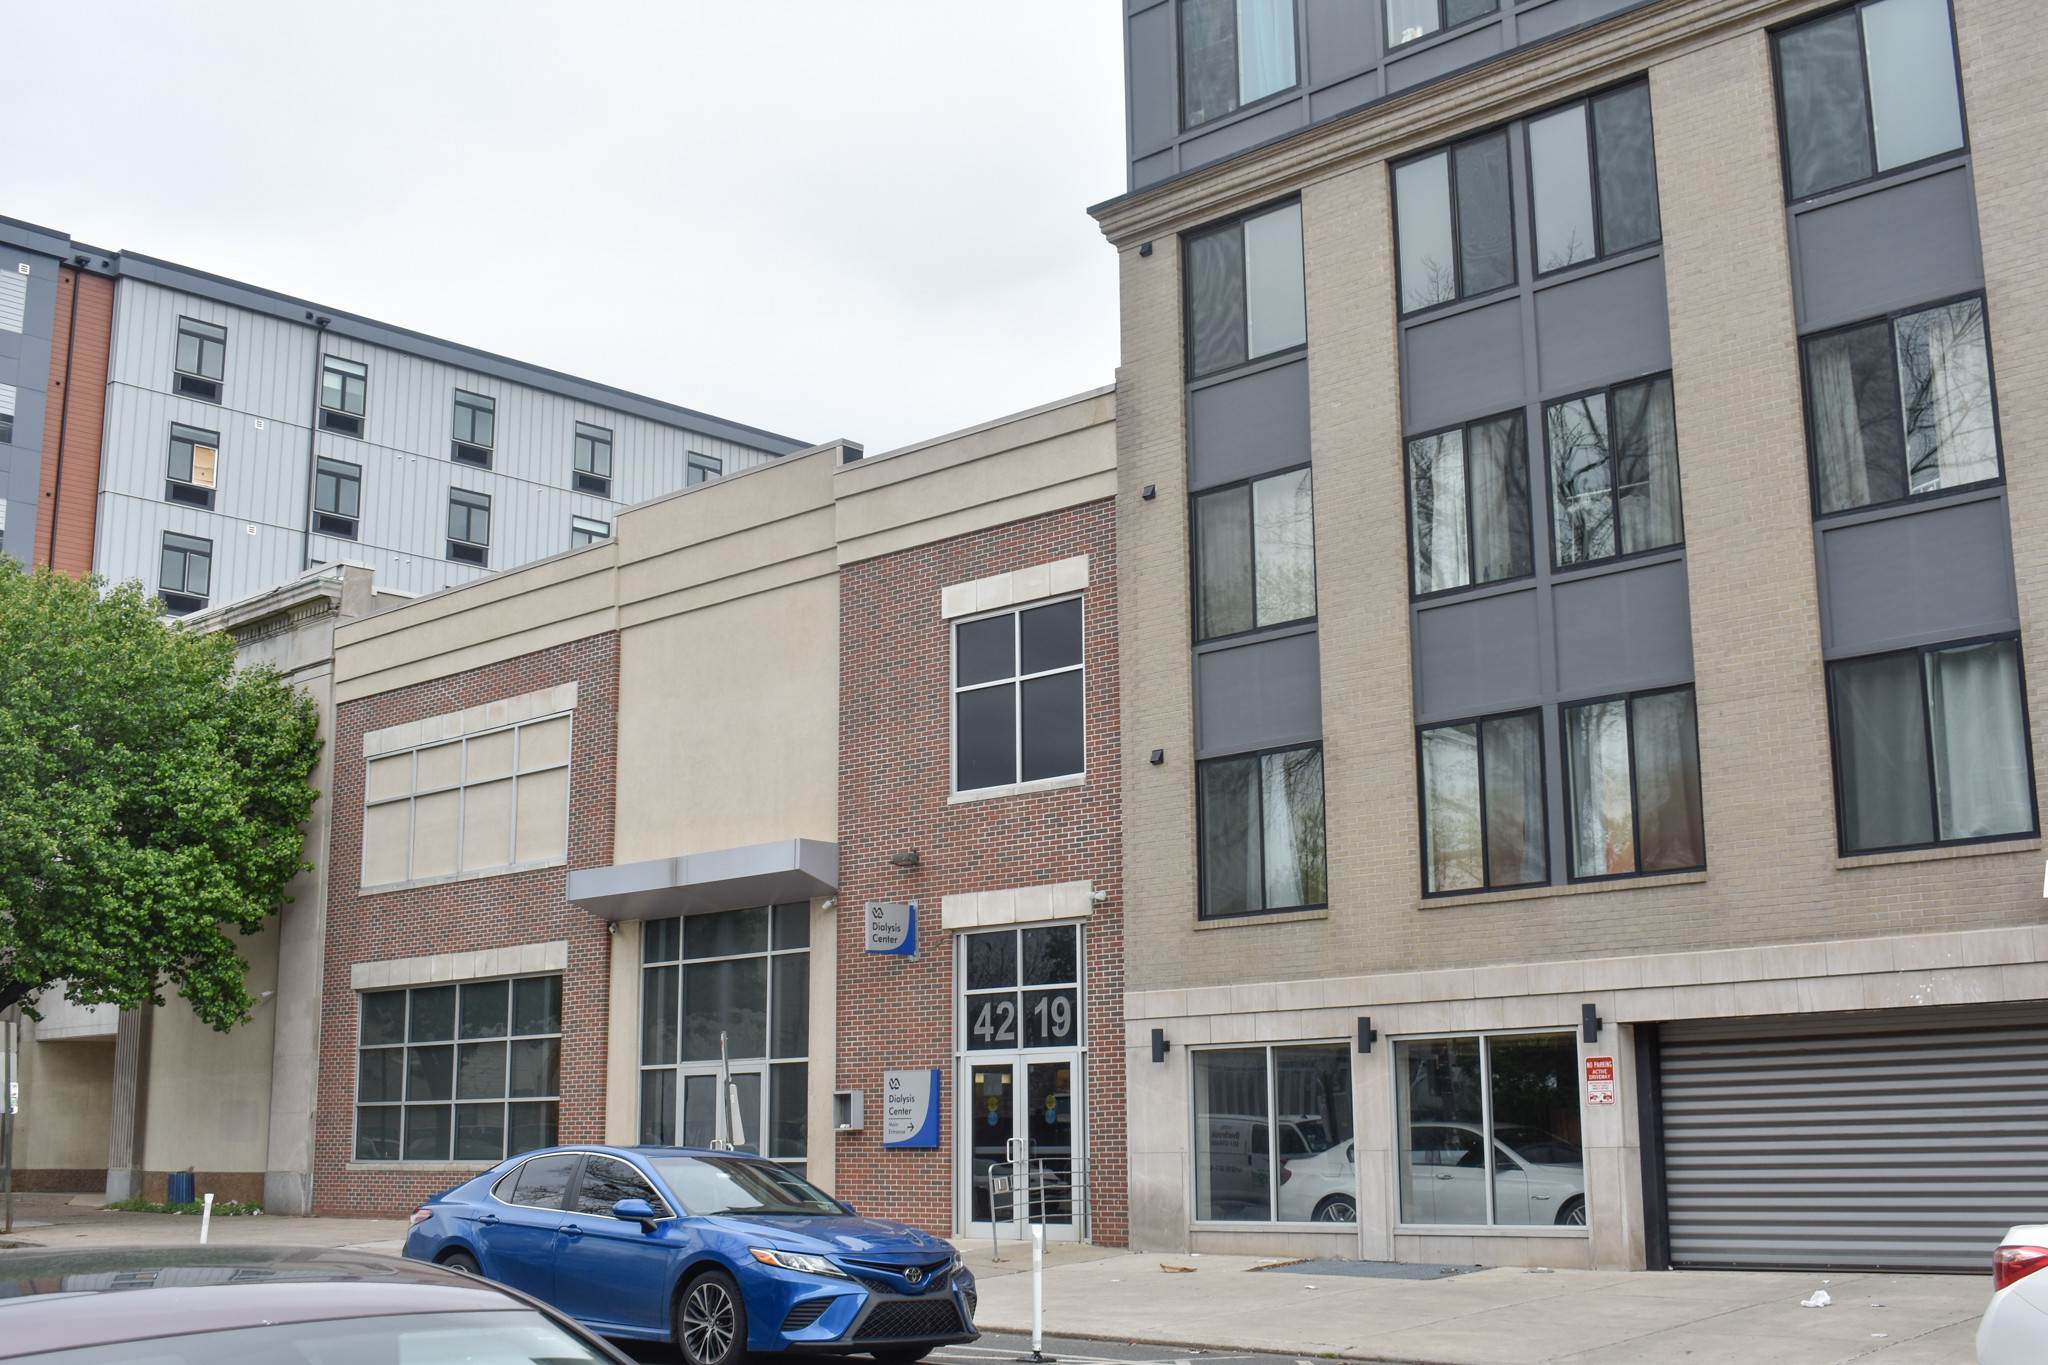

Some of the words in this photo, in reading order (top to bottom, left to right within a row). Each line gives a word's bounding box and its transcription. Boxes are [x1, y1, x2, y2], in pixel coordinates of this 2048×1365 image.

[872, 922, 901, 933] Dialysis
[872, 934, 898, 943] Center
[973, 1001, 1015, 1042] 42
[1034, 996, 1071, 1037] 19
[888, 1094, 915, 1104] Dialysis
[888, 1107, 912, 1115] Center
